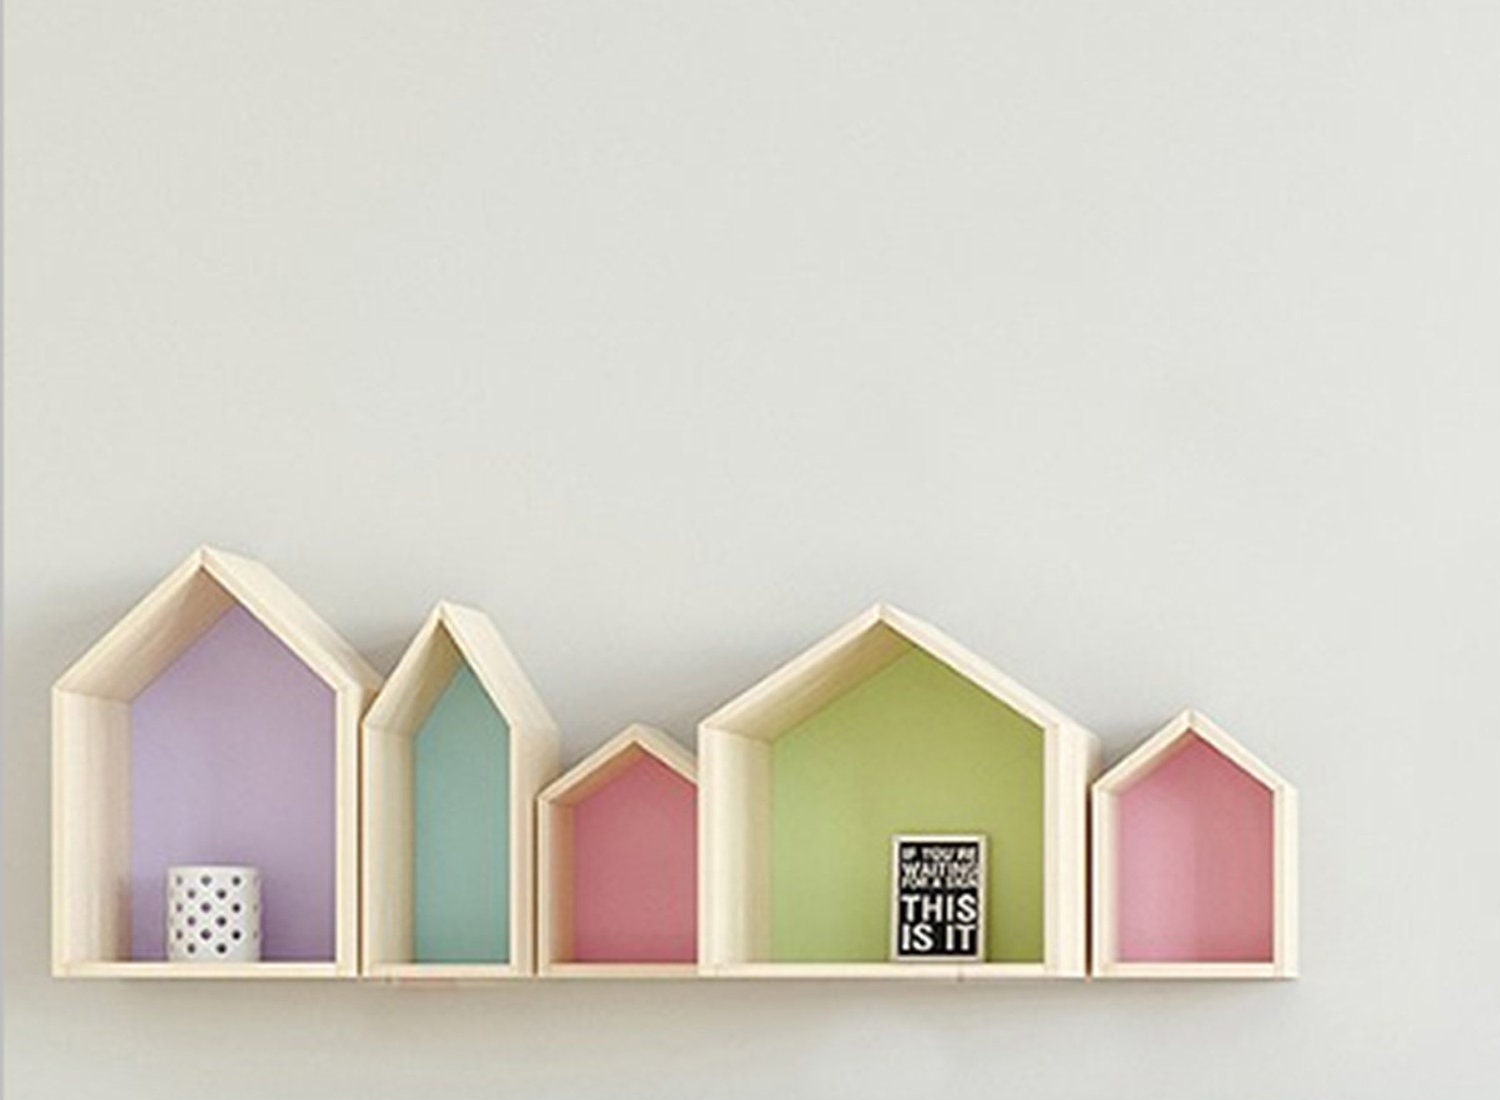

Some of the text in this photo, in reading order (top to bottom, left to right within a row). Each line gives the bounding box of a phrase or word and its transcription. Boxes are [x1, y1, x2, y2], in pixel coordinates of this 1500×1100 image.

[901, 894, 977, 922] THIS
[902, 923, 976, 950] IS IT
